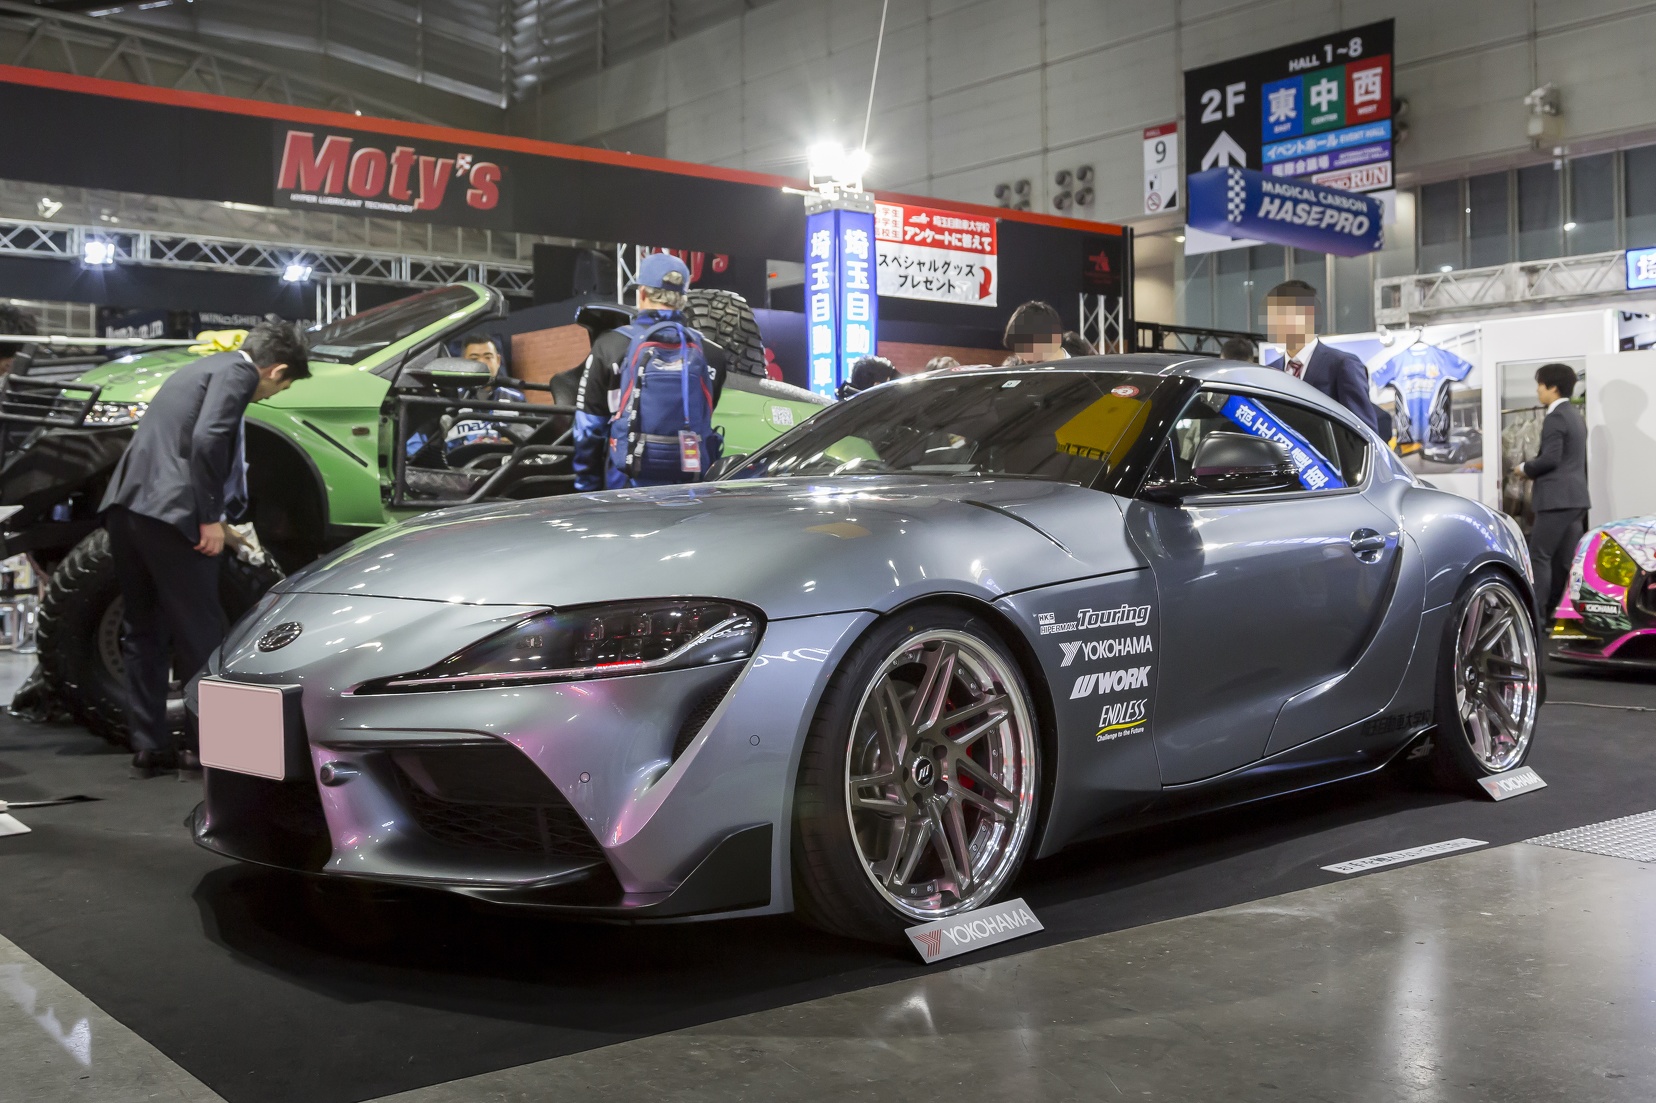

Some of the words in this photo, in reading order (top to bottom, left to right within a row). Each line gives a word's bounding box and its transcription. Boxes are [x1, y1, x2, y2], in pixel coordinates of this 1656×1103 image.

[1289, 55, 1320, 72] HALL
[1310, 77, 1338, 112] 中
[1352, 66, 1383, 105] 西
[1201, 81, 1246, 124] 2F
[1268, 87, 1297, 123] 東
[1155, 140, 1167, 163] 9
[1267, 133, 1338, 159] イベントホール
[277, 130, 502, 211] Moty's
[1351, 166, 1387, 189] RUN
[1261, 180, 1318, 202] MAGICAL
[1319, 191, 1368, 213] CARBON
[1257, 197, 1370, 236] HASEPRO
[903, 225, 993, 252] アンケートに答えて
[878, 253, 976, 278] スペシャルグッズ
[898, 274, 956, 294] プレゼント
[1038, 613, 1055, 624] HKS
[1040, 621, 1077, 635] HIPERMAX
[1077, 604, 1151, 630] Touring
[1585, 603, 1618, 615] YOKOHAMA
[1082, 635, 1153, 661] YOKOHAMA
[1098, 666, 1151, 694] WORK
[1099, 699, 1147, 727] ENDLESS
[1097, 733, 1118, 742] Challenge
[1130, 727, 1144, 735] Future
[1496, 769, 1542, 793] YOKOHAMA
[942, 908, 1036, 946] YOKOHAMA
